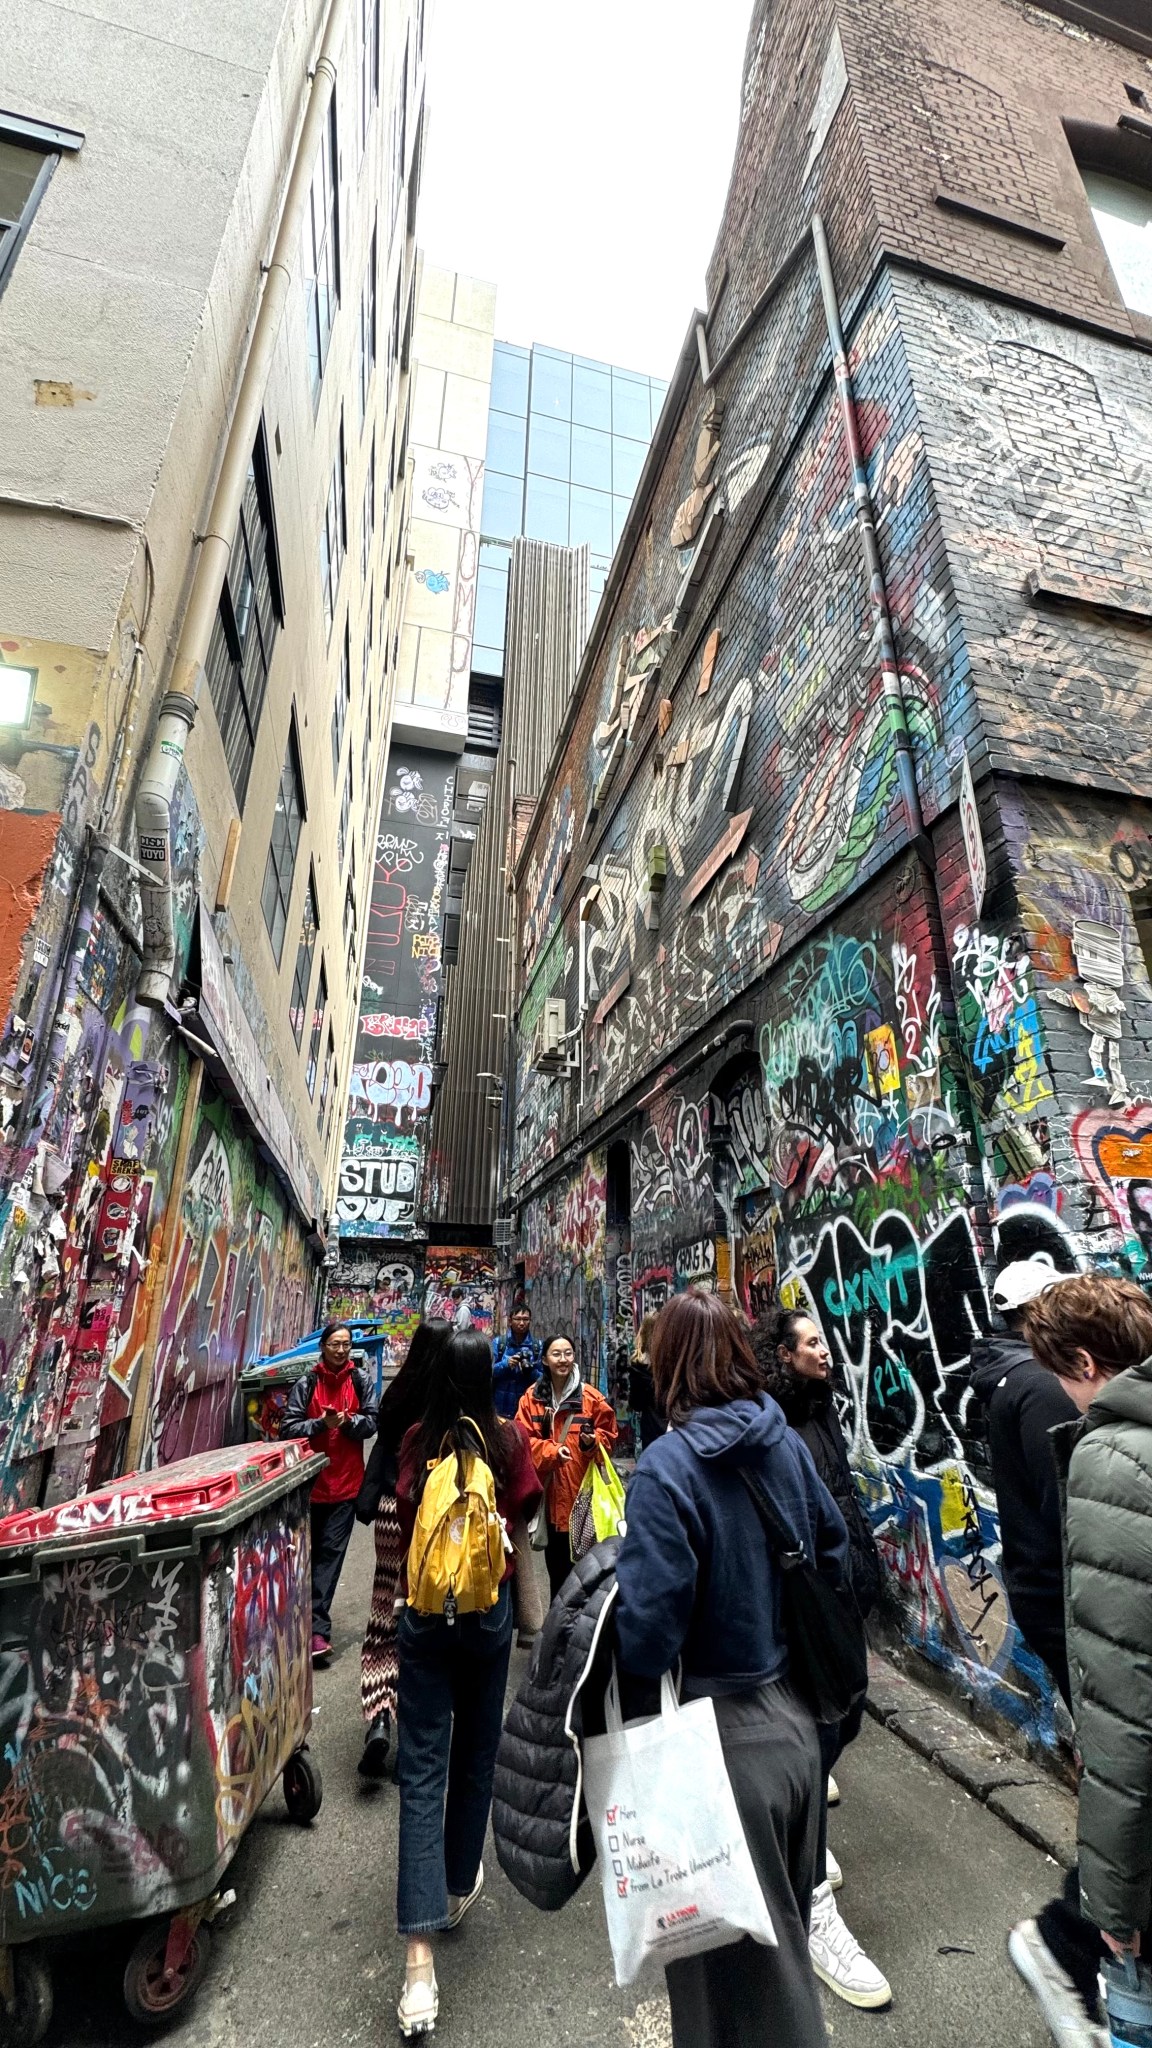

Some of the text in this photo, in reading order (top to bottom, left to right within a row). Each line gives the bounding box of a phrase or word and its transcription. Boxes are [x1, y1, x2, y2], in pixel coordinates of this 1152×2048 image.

[141, 848, 165, 859] YOYO
[339, 1158, 415, 1195] STUD
[622, 1831, 647, 1848] Nurse
[626, 1850, 661, 1872] Midwife
[630, 1844, 732, 1893] from La Trobe University
